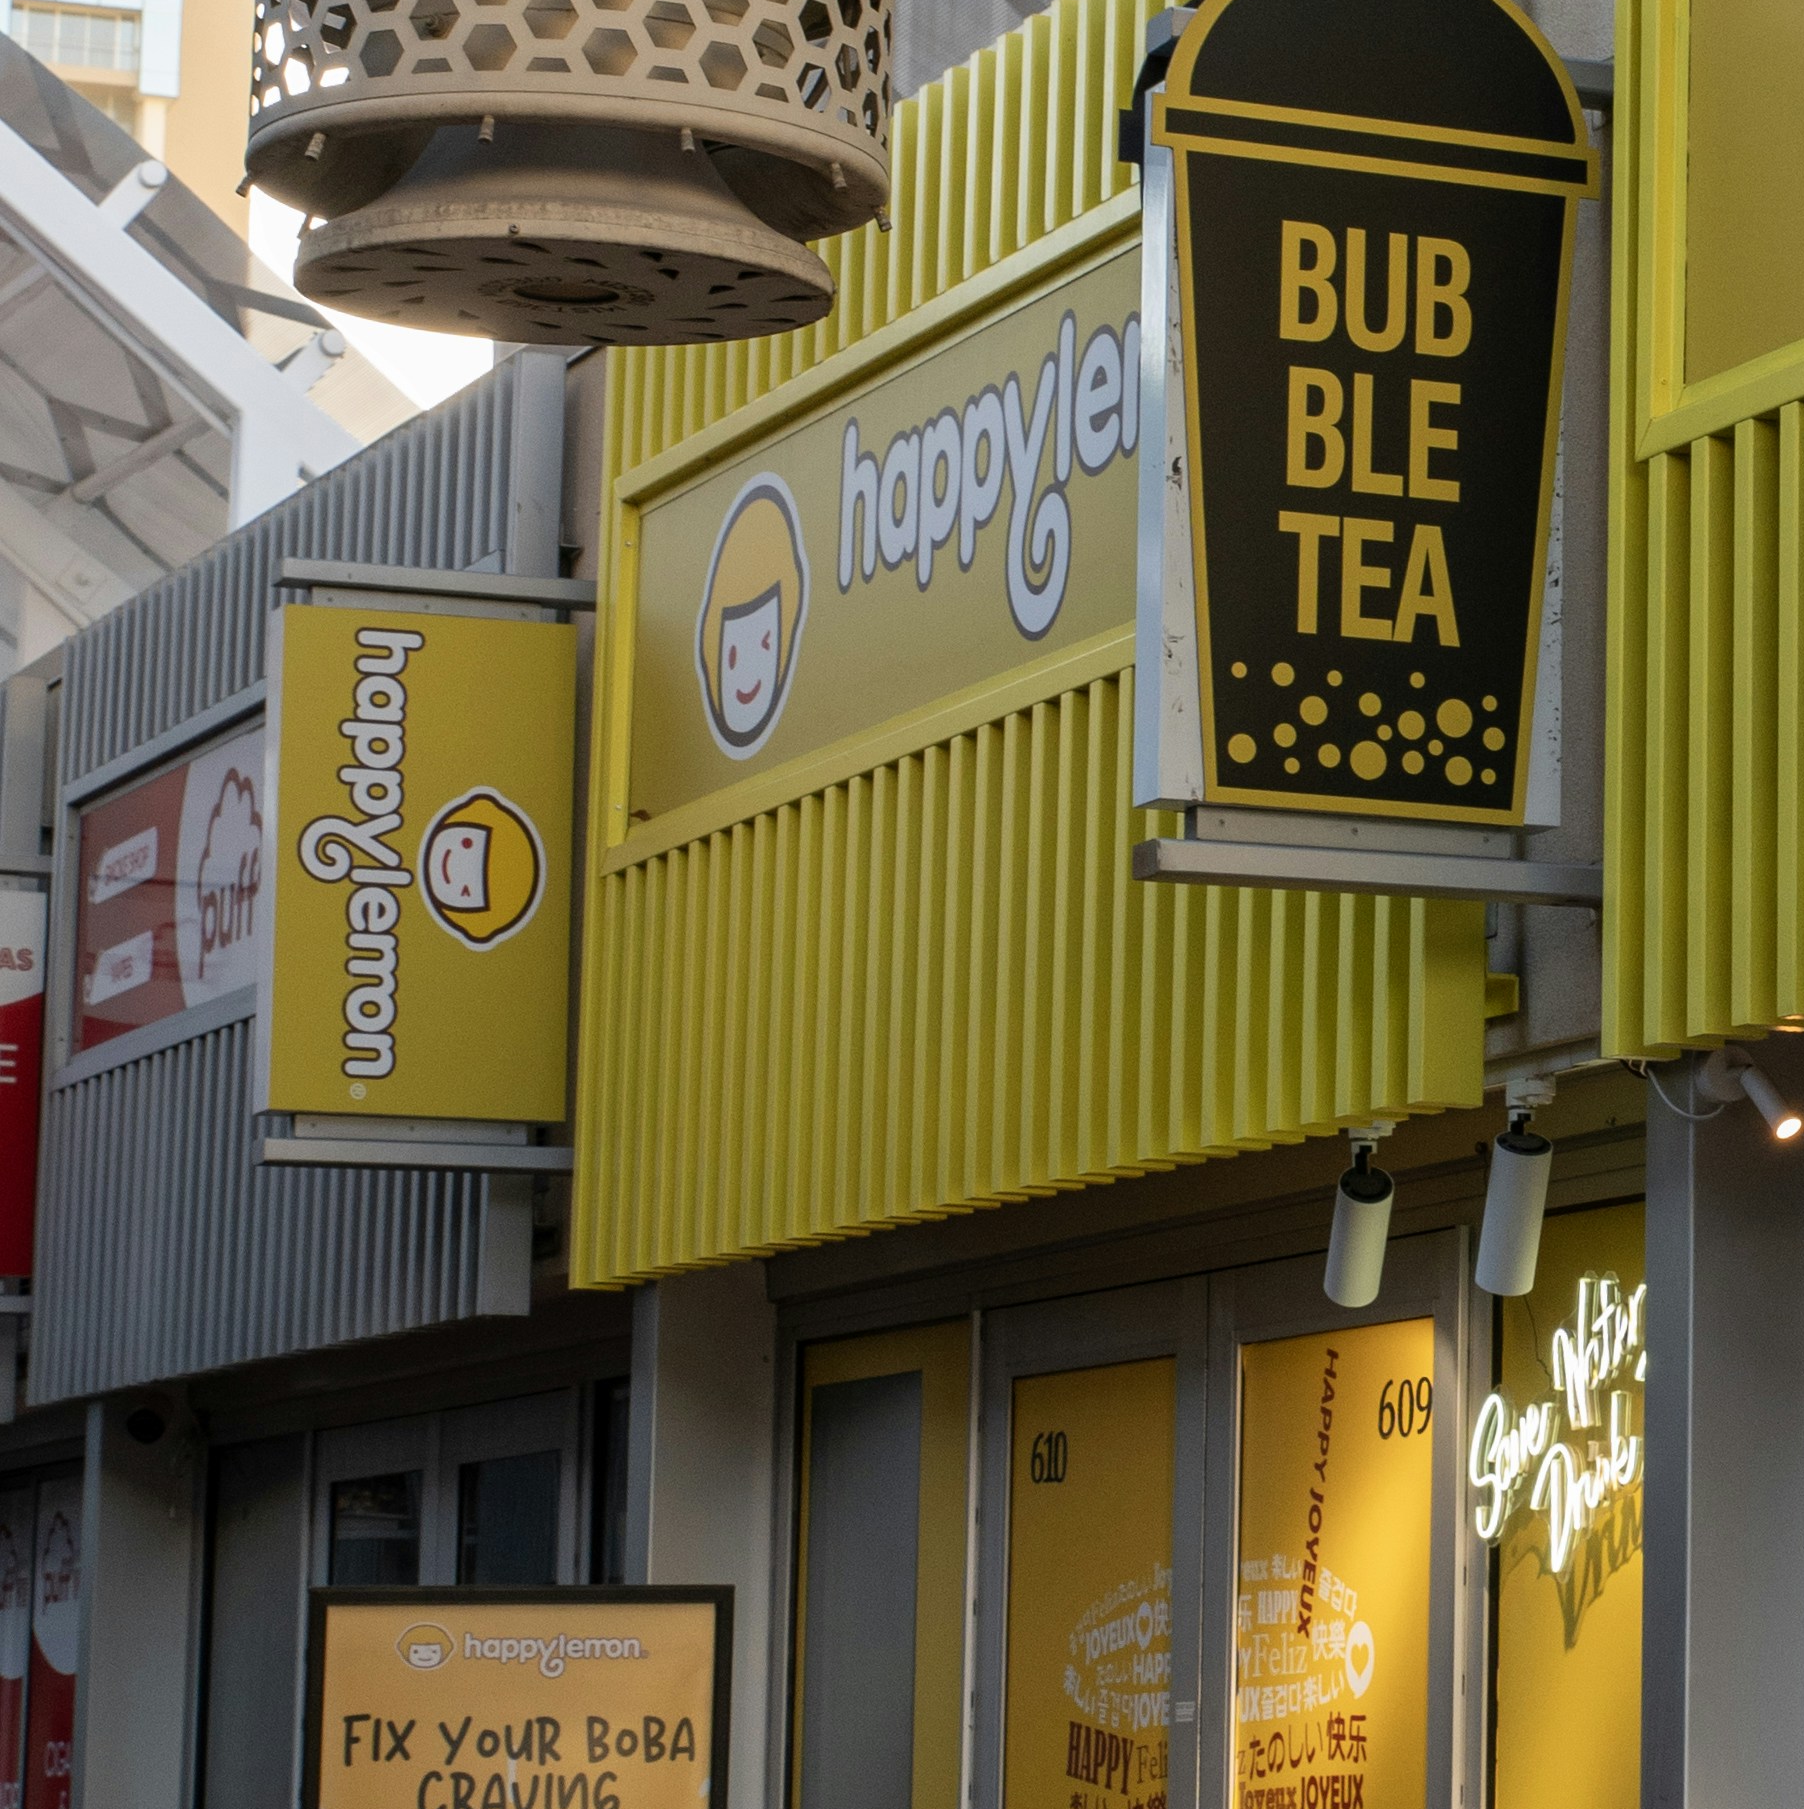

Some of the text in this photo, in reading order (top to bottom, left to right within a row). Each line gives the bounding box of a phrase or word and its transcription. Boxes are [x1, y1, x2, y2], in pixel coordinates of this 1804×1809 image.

[1279, 221, 1472, 358] BUB
[1285, 367, 1461, 503] BLE
[1279, 511, 1459, 649] TEA
[1378, 1376, 1433, 1440] 609
[1030, 1430, 1068, 1484] 610
[1297, 1348, 1339, 1639] HAPPY JOYEUX
[1470, 1392, 1556, 1540] Save
[344, 1714, 695, 1766] FIX YOUR BOBA
[1066, 1720, 1135, 1796] HAPPY
[1249, 1721, 1324, 1780] たのしい
[1326, 1710, 1367, 1764] 快乐
